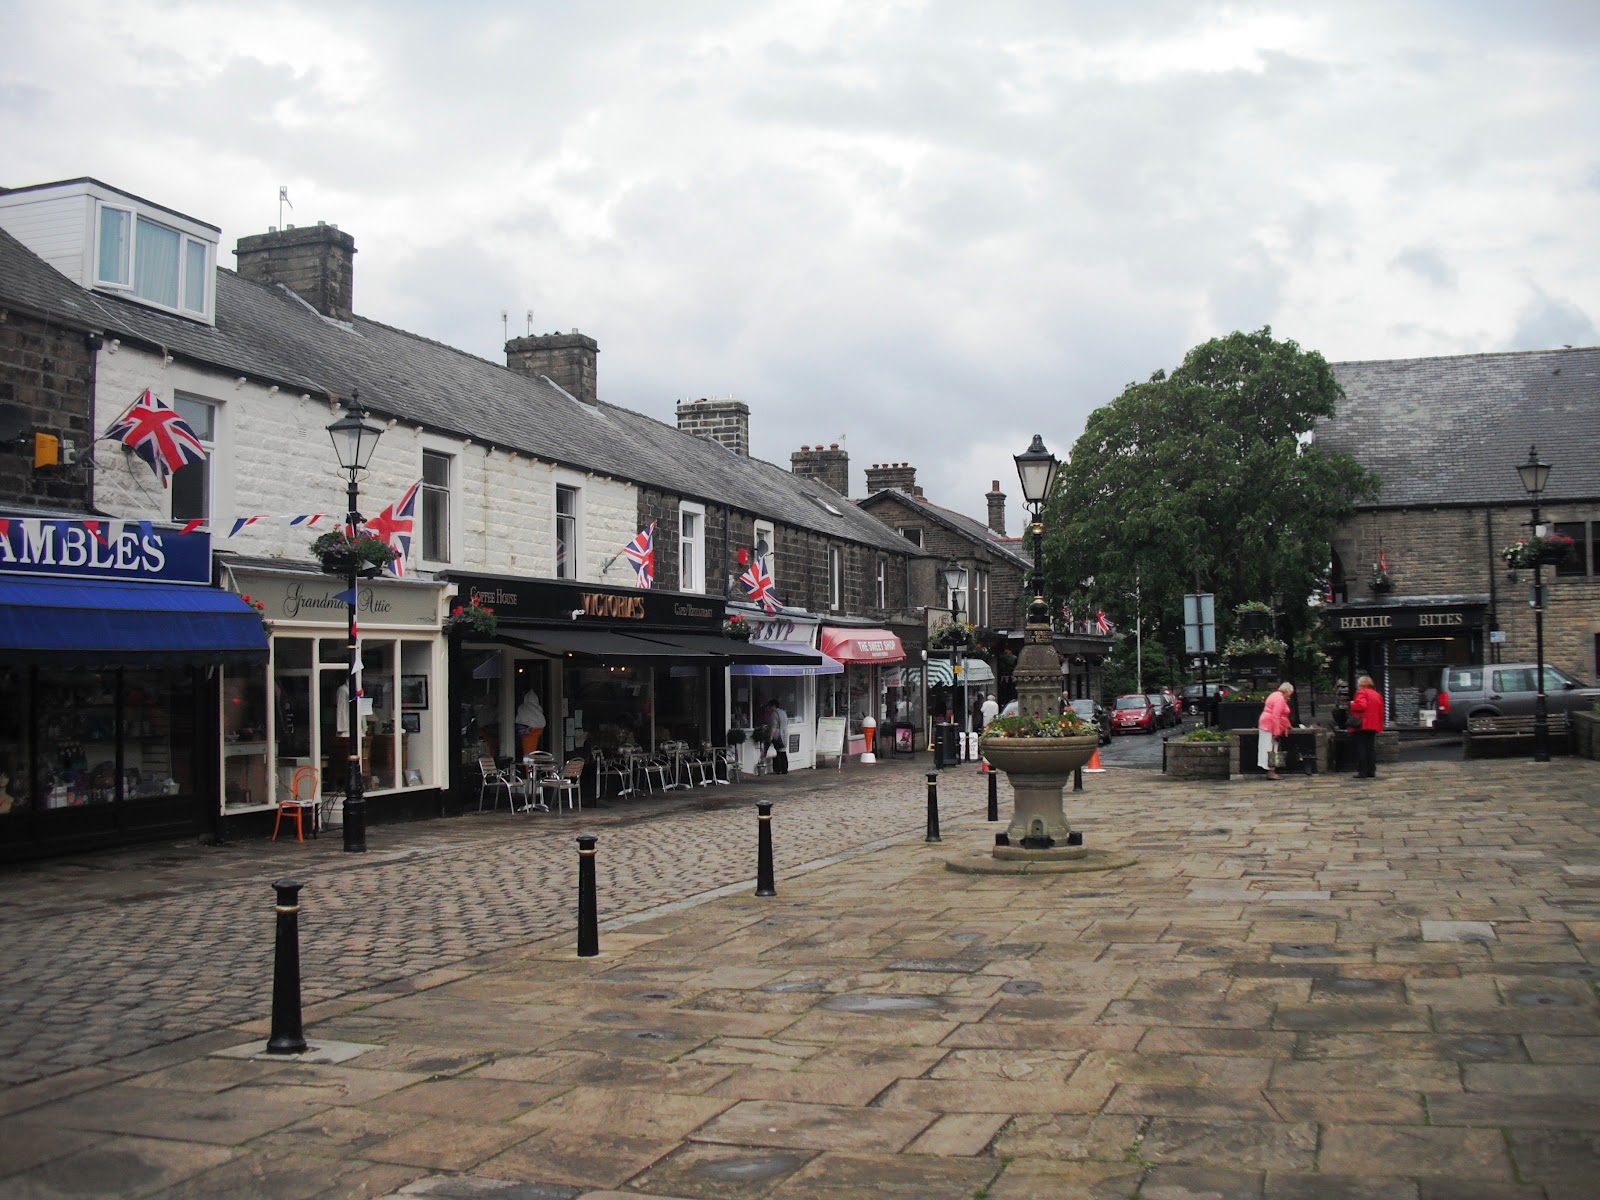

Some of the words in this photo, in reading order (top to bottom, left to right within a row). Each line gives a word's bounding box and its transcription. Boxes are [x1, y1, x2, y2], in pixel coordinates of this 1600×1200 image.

[357, 588, 392, 613] Attic
[496, 588, 517, 605] HOUSE
[579, 592, 645, 619] VICTORIA'S
[1419, 613, 1463, 627] BITES
[754, 620, 796, 640] RSVP
[857, 641, 869, 652] THE
[868, 641, 885, 652] SWEET
[883, 640, 896, 652] SHOP
